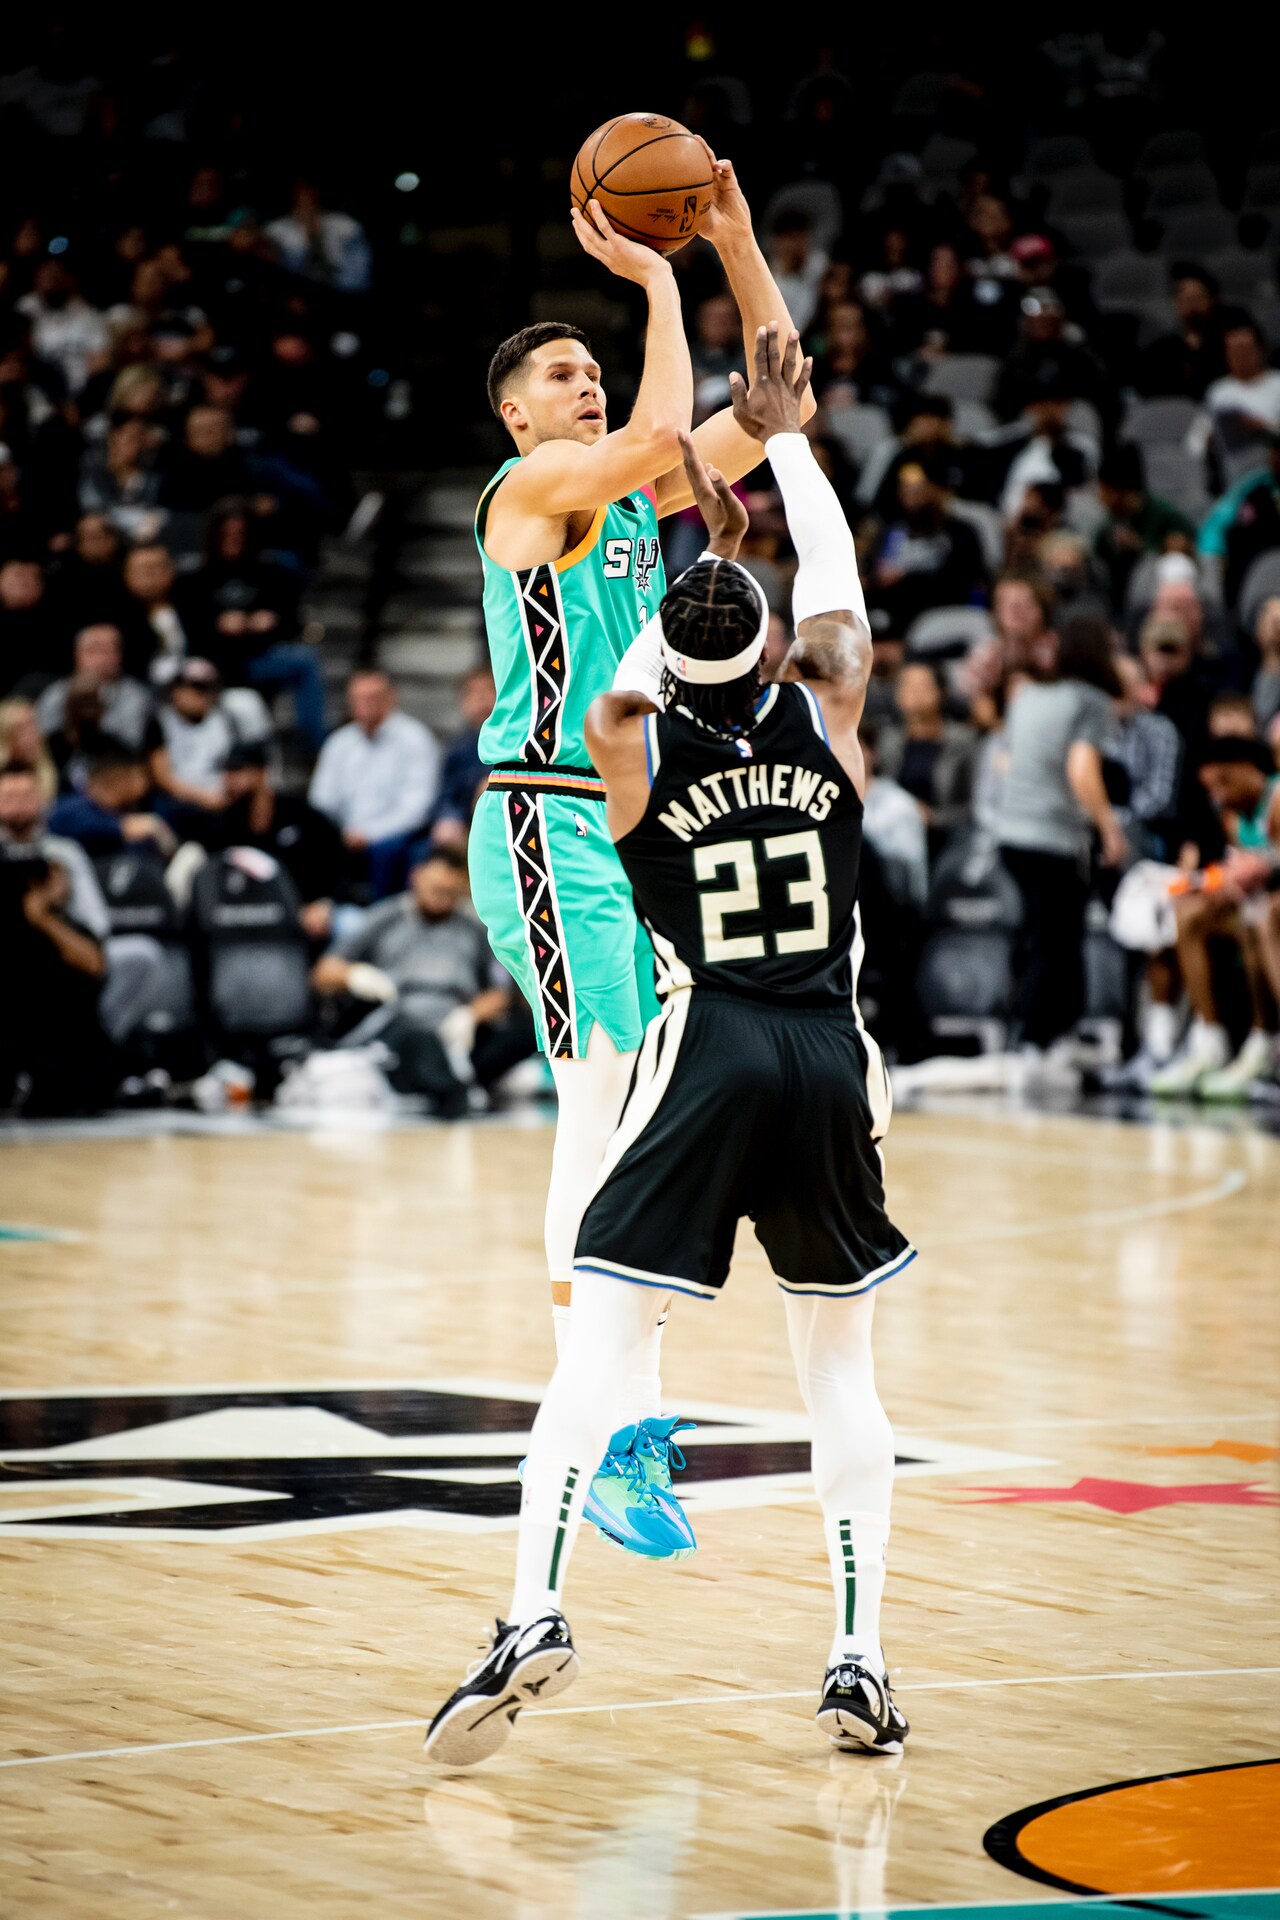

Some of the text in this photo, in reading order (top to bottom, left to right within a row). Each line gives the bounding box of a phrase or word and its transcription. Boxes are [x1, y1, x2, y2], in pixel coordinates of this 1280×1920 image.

[603, 537, 660, 597] SU
[657, 764, 840, 843] MATTHEWS
[693, 829, 829, 963] 23
